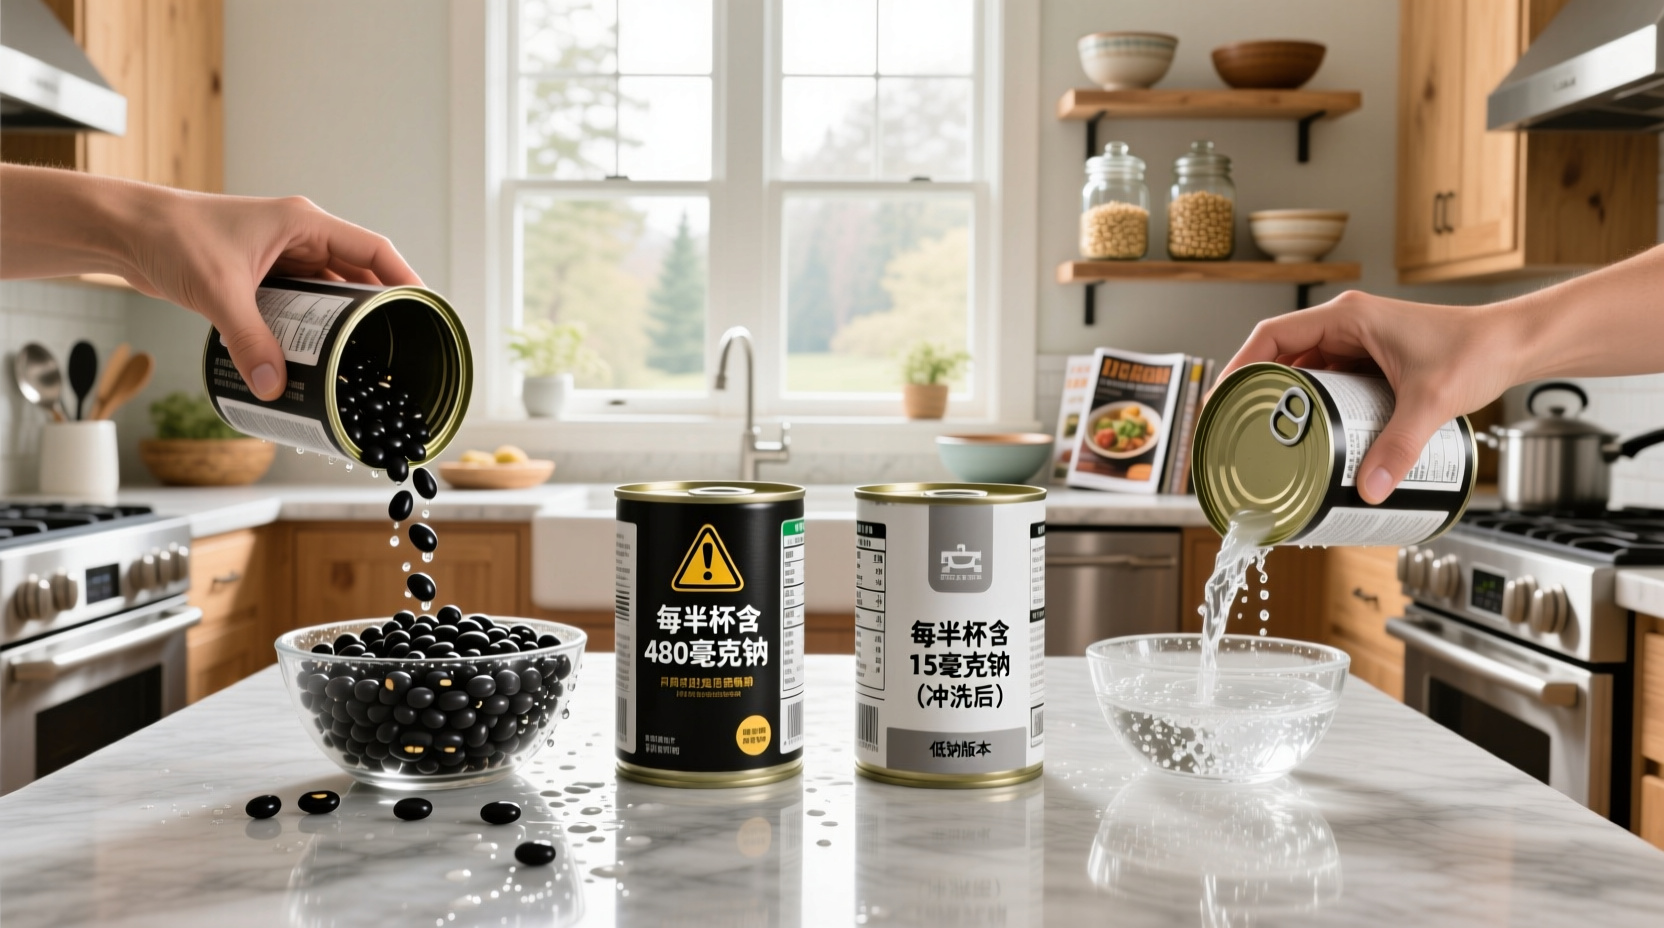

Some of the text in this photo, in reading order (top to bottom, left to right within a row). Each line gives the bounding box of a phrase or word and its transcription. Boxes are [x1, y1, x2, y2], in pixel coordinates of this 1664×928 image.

[656, 604, 762, 635] 每半杯含
[910, 619, 1010, 648] 每半杯含
[644, 638, 769, 668] 480毫克钠
[909, 651, 1010, 678] 15毫克钠
